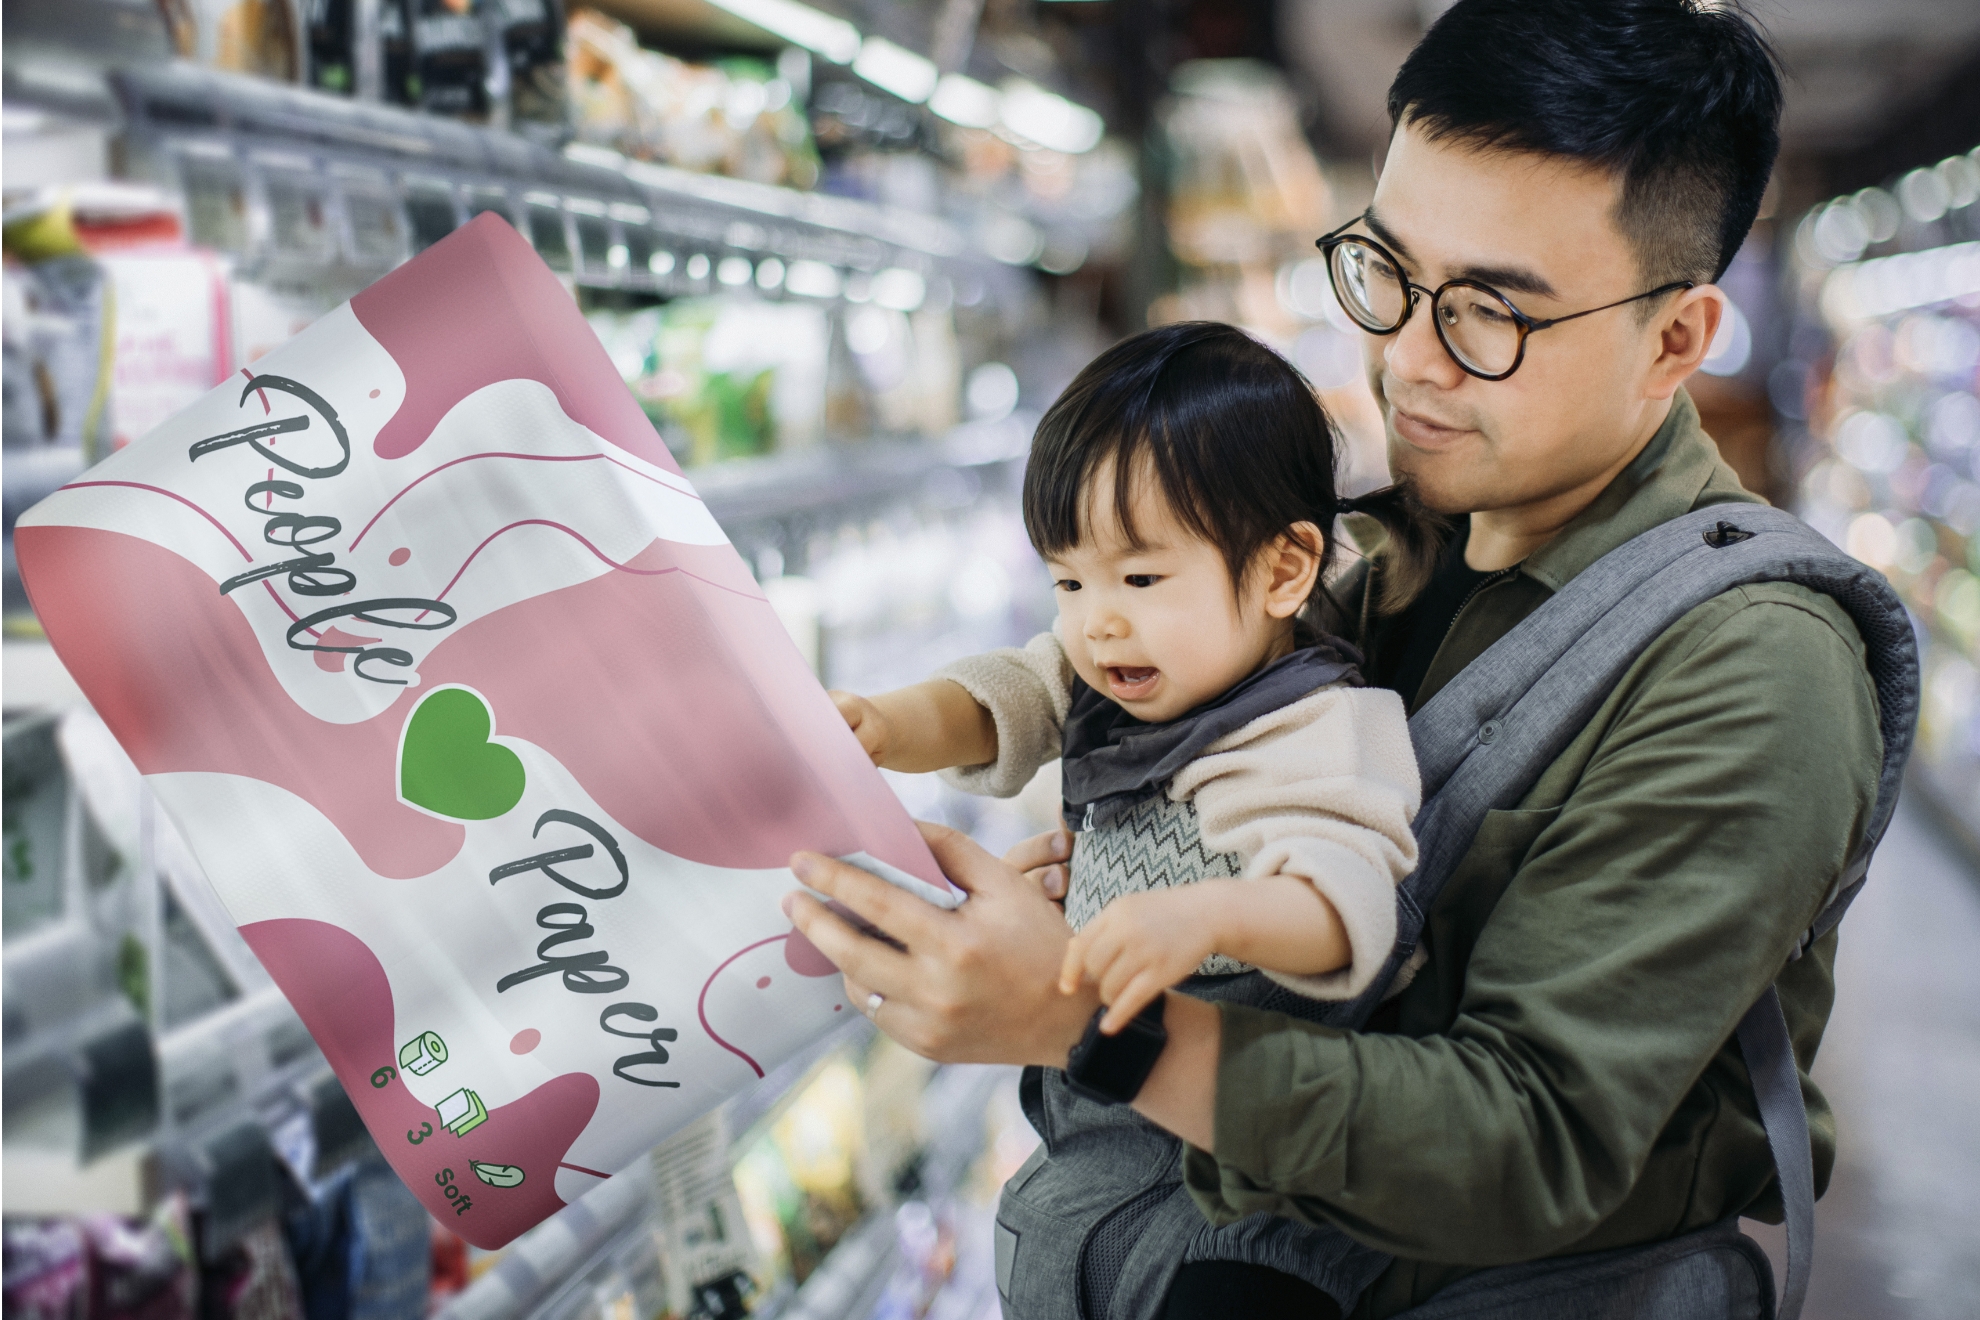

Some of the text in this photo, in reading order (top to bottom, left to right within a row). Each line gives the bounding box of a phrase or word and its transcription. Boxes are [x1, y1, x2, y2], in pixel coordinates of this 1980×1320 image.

[189, 374, 680, 1088] People Paper
[370, 1065, 397, 1089] 6
[407, 1122, 433, 1145] 3
[435, 1168, 473, 1216] Soft
